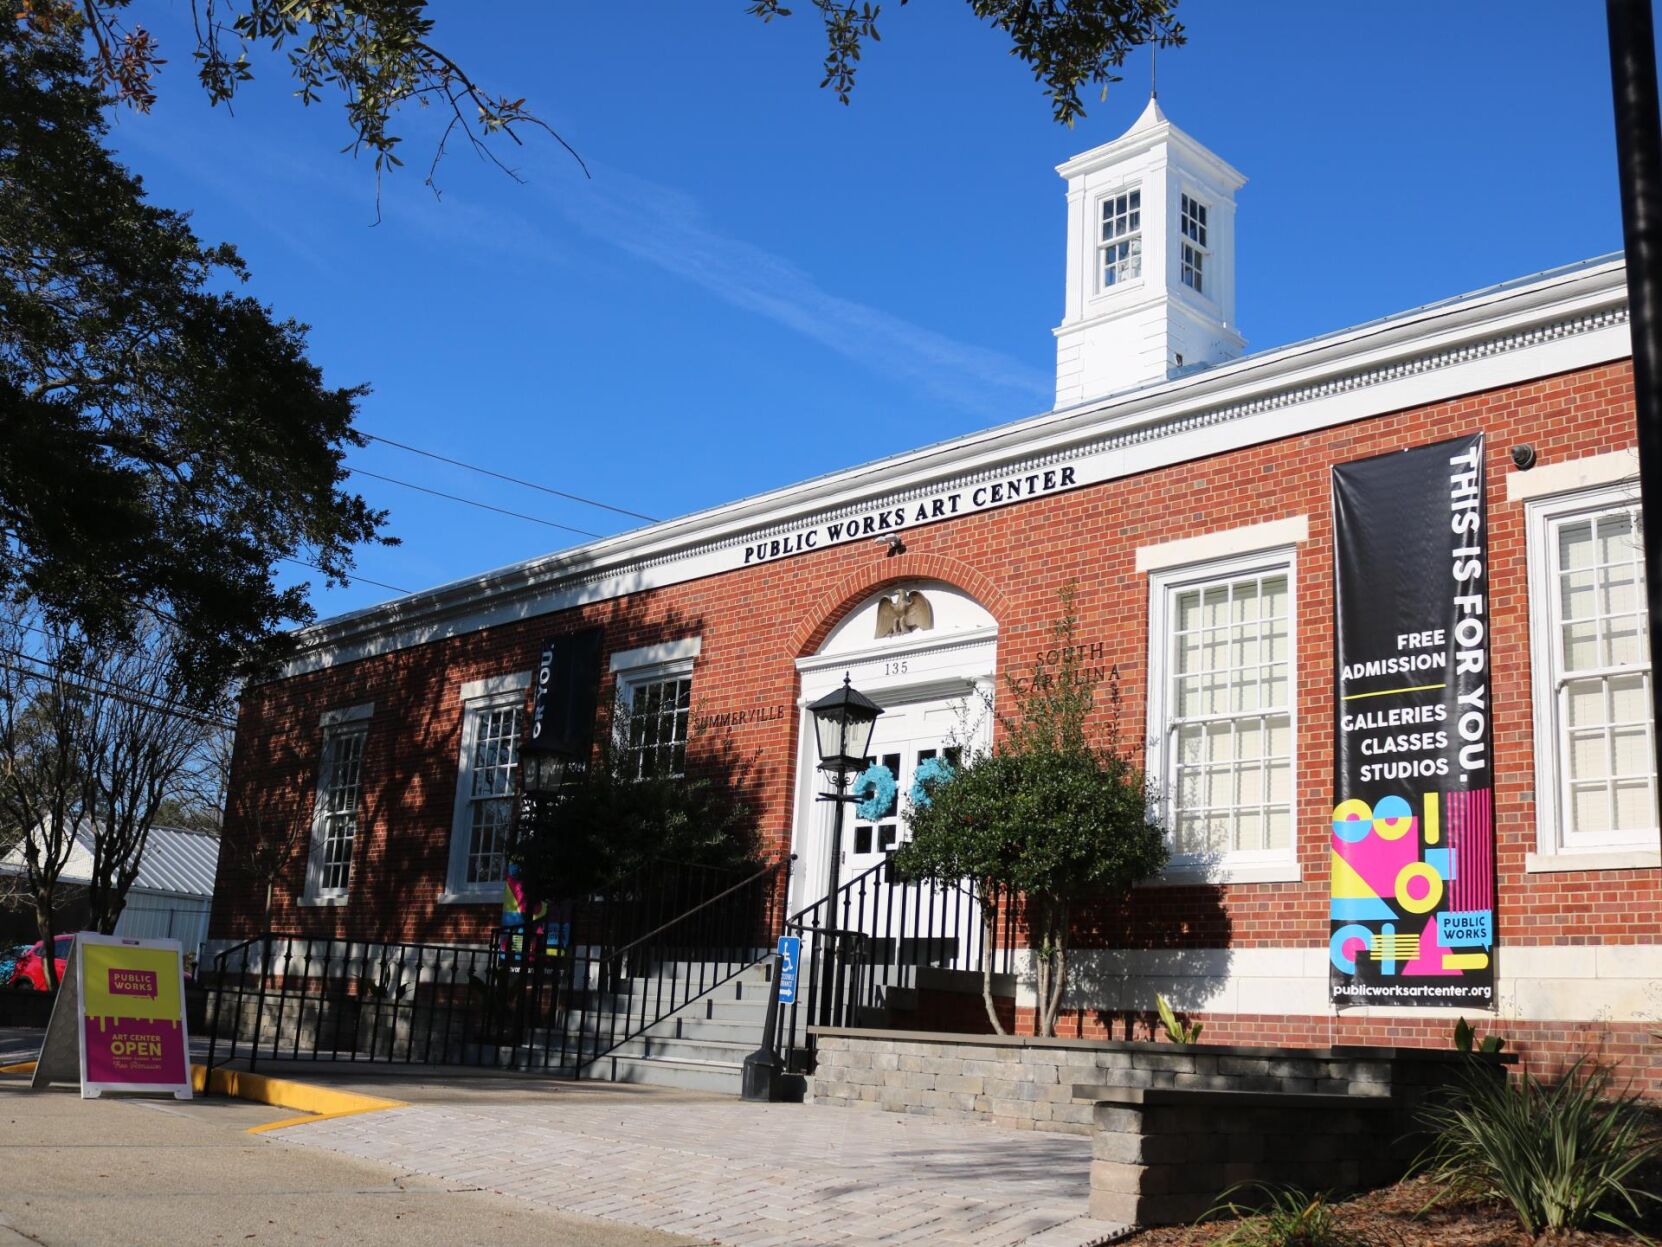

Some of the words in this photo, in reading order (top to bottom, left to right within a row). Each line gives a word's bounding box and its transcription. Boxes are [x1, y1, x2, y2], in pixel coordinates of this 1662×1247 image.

[1450, 446, 1480, 535] THIS
[744, 530, 818, 563] PUBLIC
[827, 508, 905, 541] WORKS
[915, 494, 962, 521] ART
[972, 466, 1077, 507] CENTER
[1452, 546, 1482, 582] IS
[1397, 629, 1446, 651] FREE
[1453, 594, 1484, 676] FOR
[884, 661, 908, 676] 135
[1341, 651, 1447, 681] ADMISSION
[1015, 664, 1120, 694] CARLINA
[694, 705, 784, 730] SUMMERVILLE
[1340, 703, 1447, 732] GALLERIES
[1361, 730, 1448, 756] CLASSES
[1457, 684, 1485, 782] YOU.
[1360, 758, 1449, 782] STUDIOS
[1443, 916, 1485, 928] PUBLIC
[1444, 928, 1487, 940] WORKS
[114, 973, 151, 983] PUBLIC
[114, 982, 153, 991] WORKS
[1333, 984, 1491, 998] publicworksartcenter.org
[111, 1041, 161, 1056] OPEN
[129, 1034, 161, 1042] CENTER
